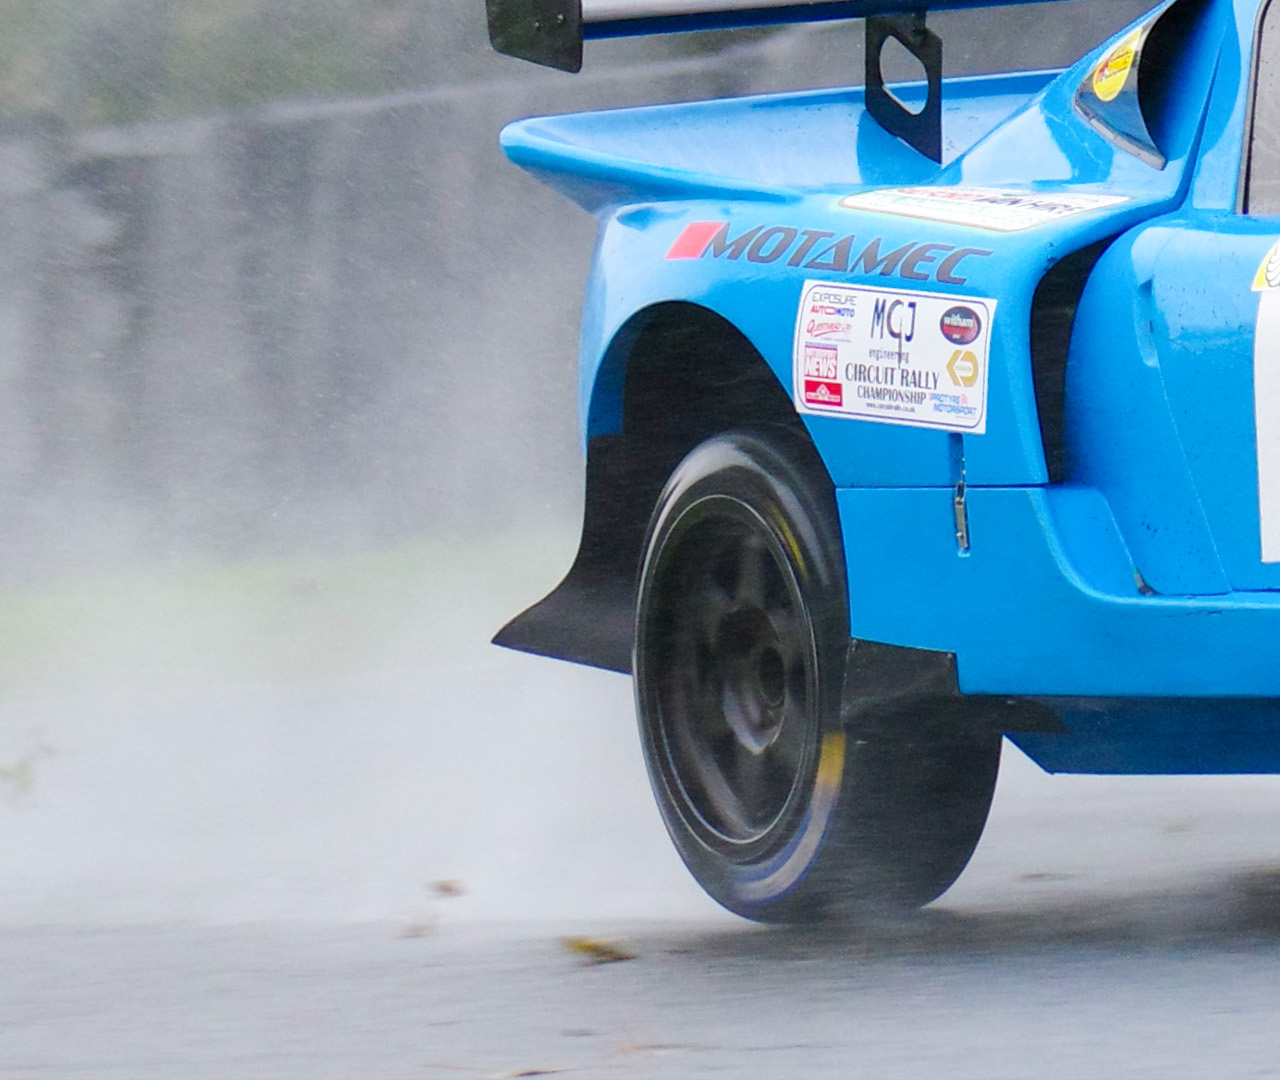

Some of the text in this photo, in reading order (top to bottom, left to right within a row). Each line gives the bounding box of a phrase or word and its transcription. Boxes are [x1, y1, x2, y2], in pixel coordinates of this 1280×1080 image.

[700, 222, 994, 285] MOTAMEC
[811, 292, 858, 306] EXPOSURE
[804, 355, 837, 379] NEWS
[845, 362, 940, 390] CIRCUIT RALLY
[857, 384, 927, 405] CHAMPIONSHIP
